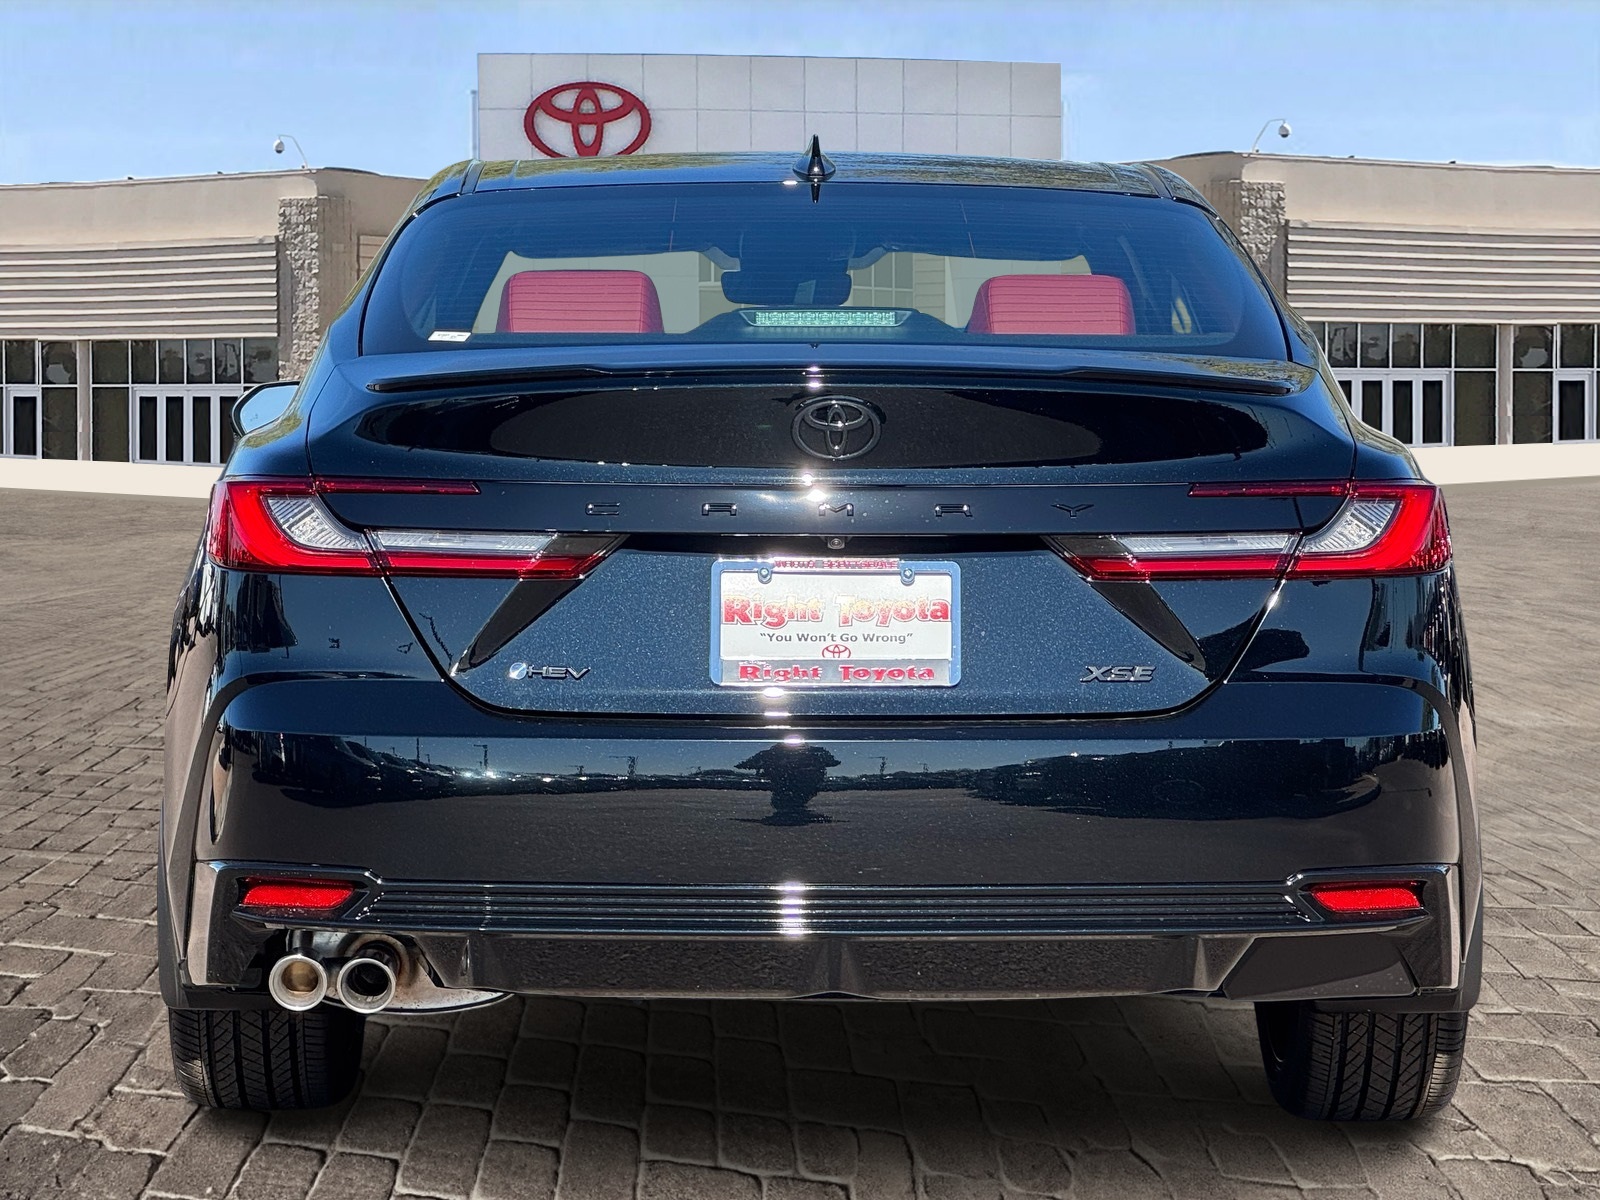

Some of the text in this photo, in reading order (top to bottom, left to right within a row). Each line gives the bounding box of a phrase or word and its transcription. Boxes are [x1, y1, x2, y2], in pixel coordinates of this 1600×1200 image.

[585, 501, 1094, 518] CAMRY
[722, 594, 952, 629] Right Toyota
[839, 632, 858, 643] Go
[528, 664, 592, 680] HEV
[738, 663, 936, 683] Right Toyota
[1080, 665, 1157, 683] XSE
